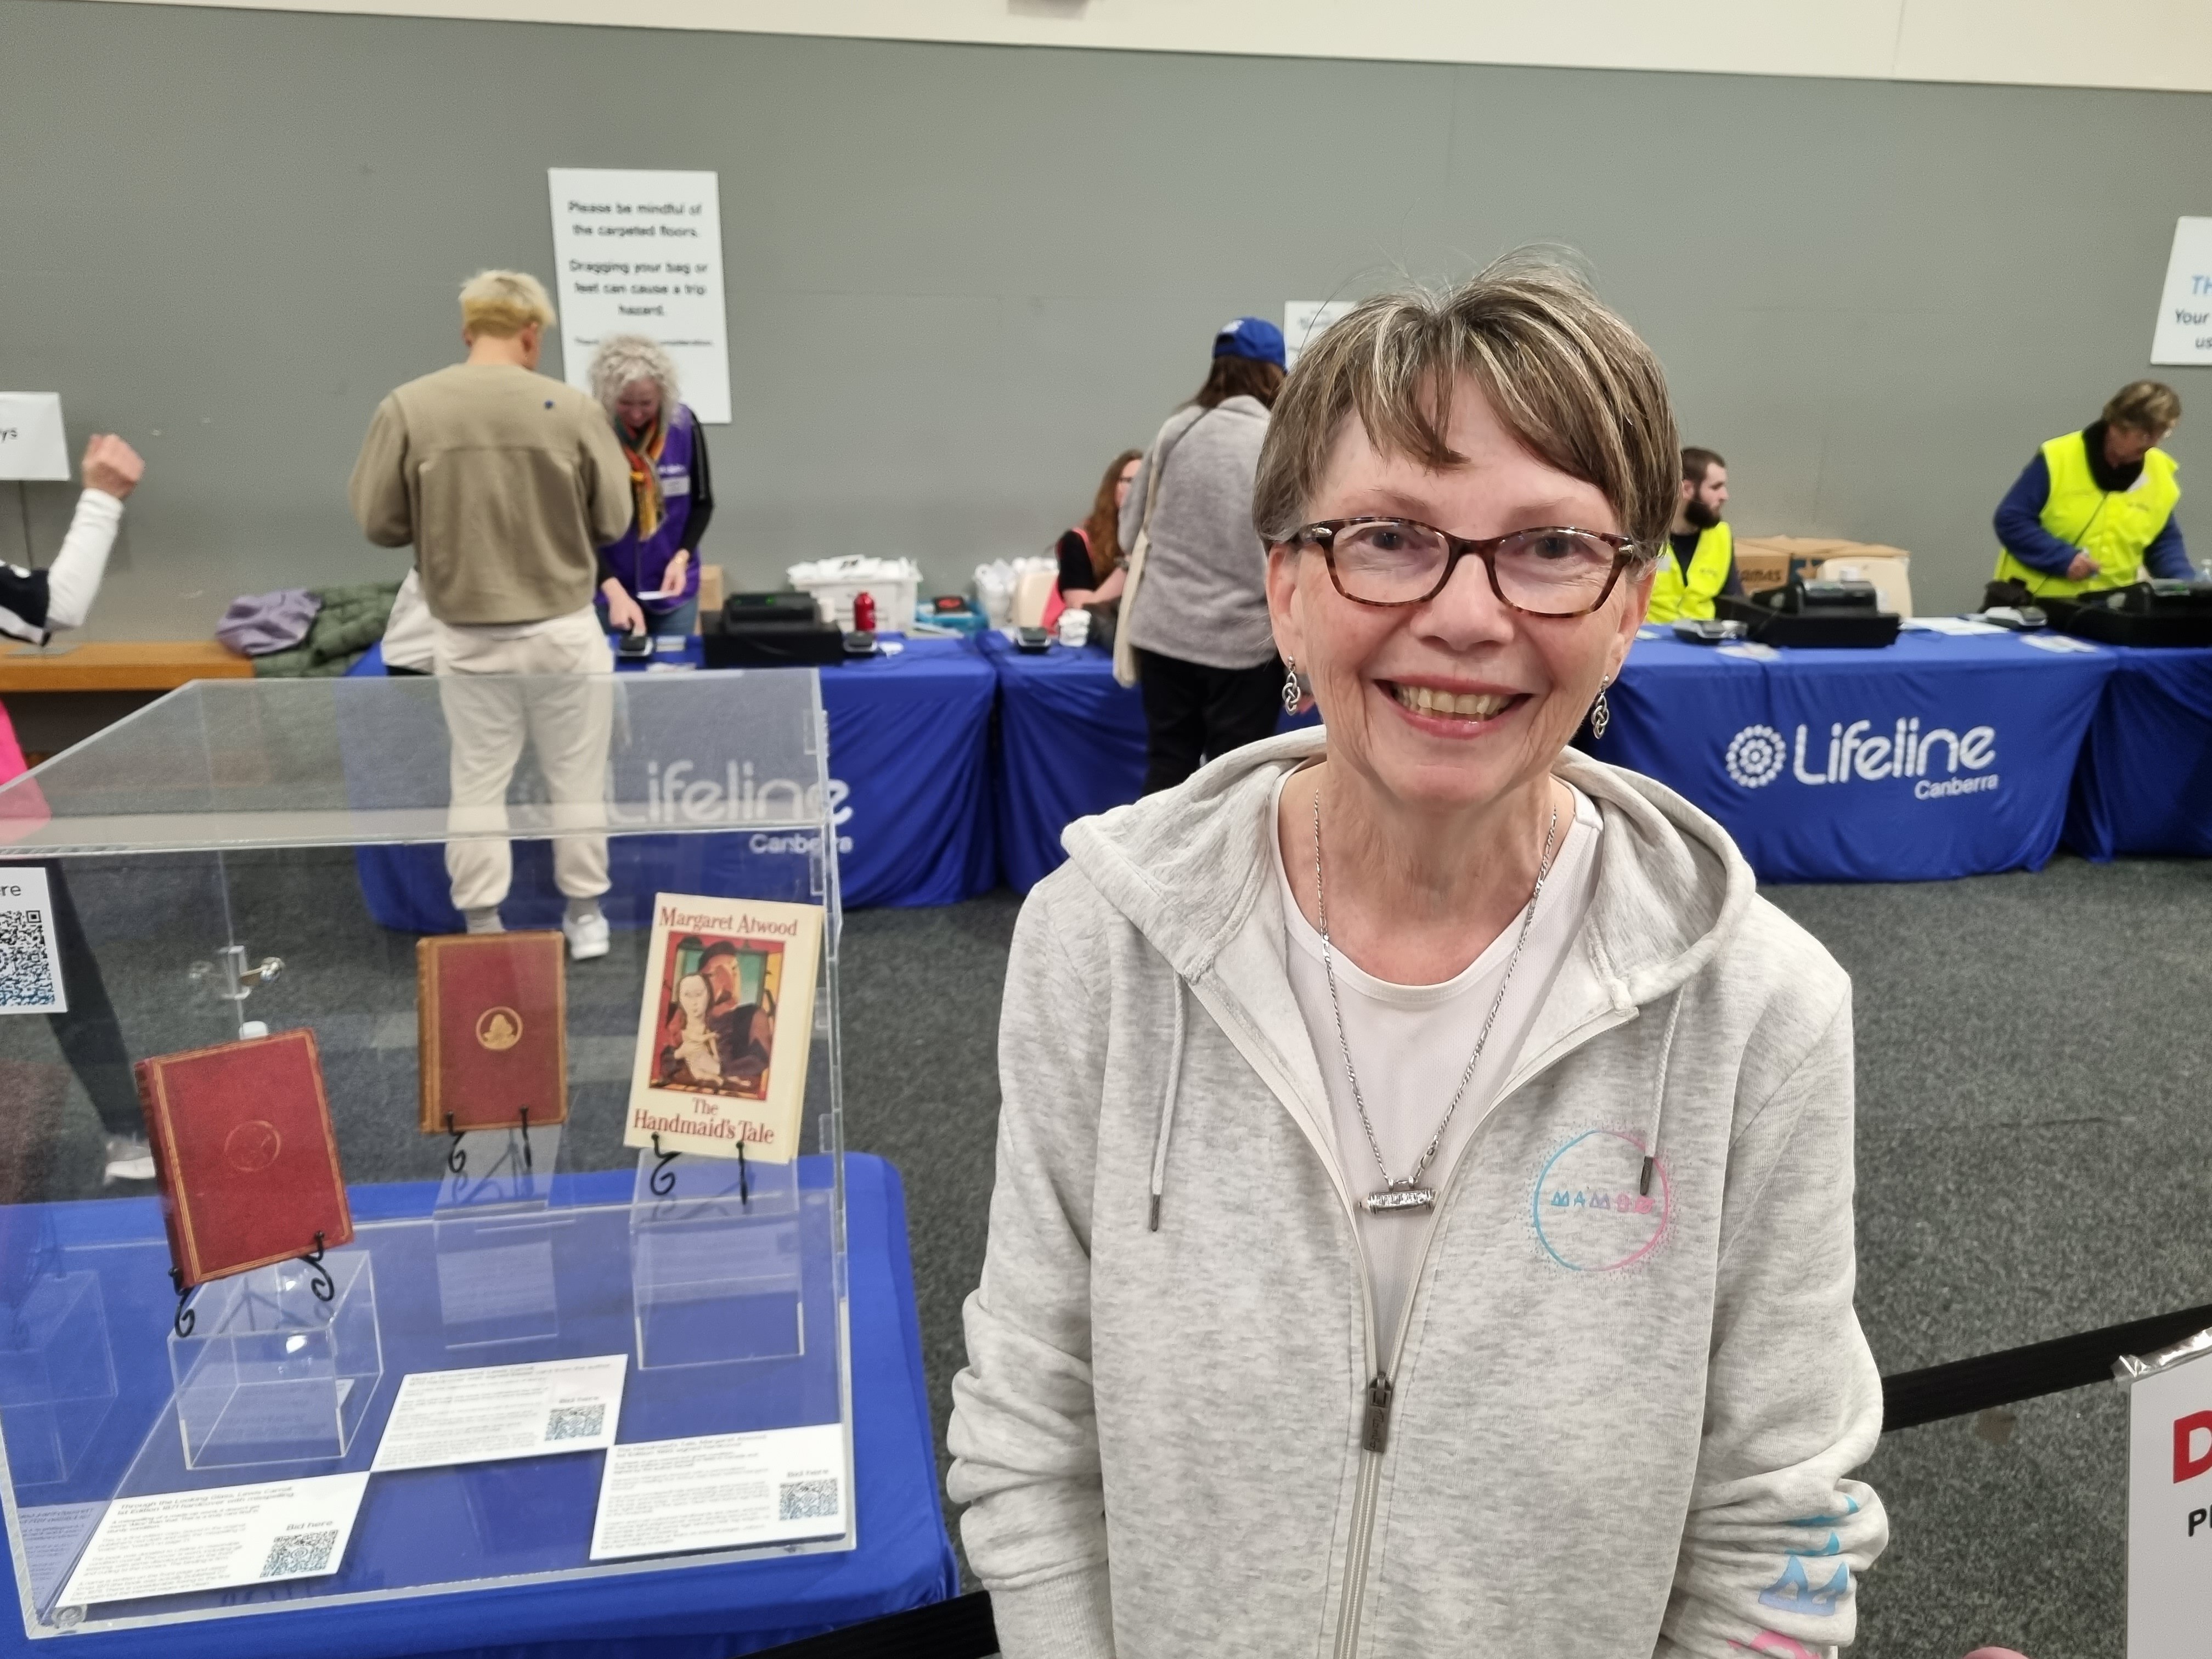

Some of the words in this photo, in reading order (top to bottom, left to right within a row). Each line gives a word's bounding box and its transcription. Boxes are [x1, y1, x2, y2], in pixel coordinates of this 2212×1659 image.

[568, 200, 611, 212] Please
[616, 201, 631, 213] be
[637, 202, 685, 214] mindful
[689, 204, 702, 214] of
[573, 224, 592, 235] the
[597, 225, 656, 237] carpeted
[569, 259, 629, 274] Dragging
[635, 263, 661, 274] your
[665, 262, 691, 274] bag
[695, 264, 708, 273] or
[574, 283, 599, 293] feet
[603, 284, 627, 294] can
[631, 285, 668, 294] cause
[674, 285, 680, 294] a
[685, 285, 706, 296] trip
[2175, 308, 2210, 324] Your
[1793, 717, 1996, 786] Lifeline
[604, 759, 854, 825] Lifeline
[1914, 774, 2000, 800] Canberra
[659, 906, 734, 933] Margaret
[737, 914, 799, 936] Atwood
[692, 1097, 719, 1115] The
[634, 1108, 736, 1139] Handmaid's
[739, 1120, 775, 1143] Tale
[121, 1501, 156, 1510] Through
[174, 1496, 208, 1504] Looking
[286, 1522, 305, 1531] Bid
[307, 1520, 333, 1528] here
[2187, 1503, 2212, 1538] P
